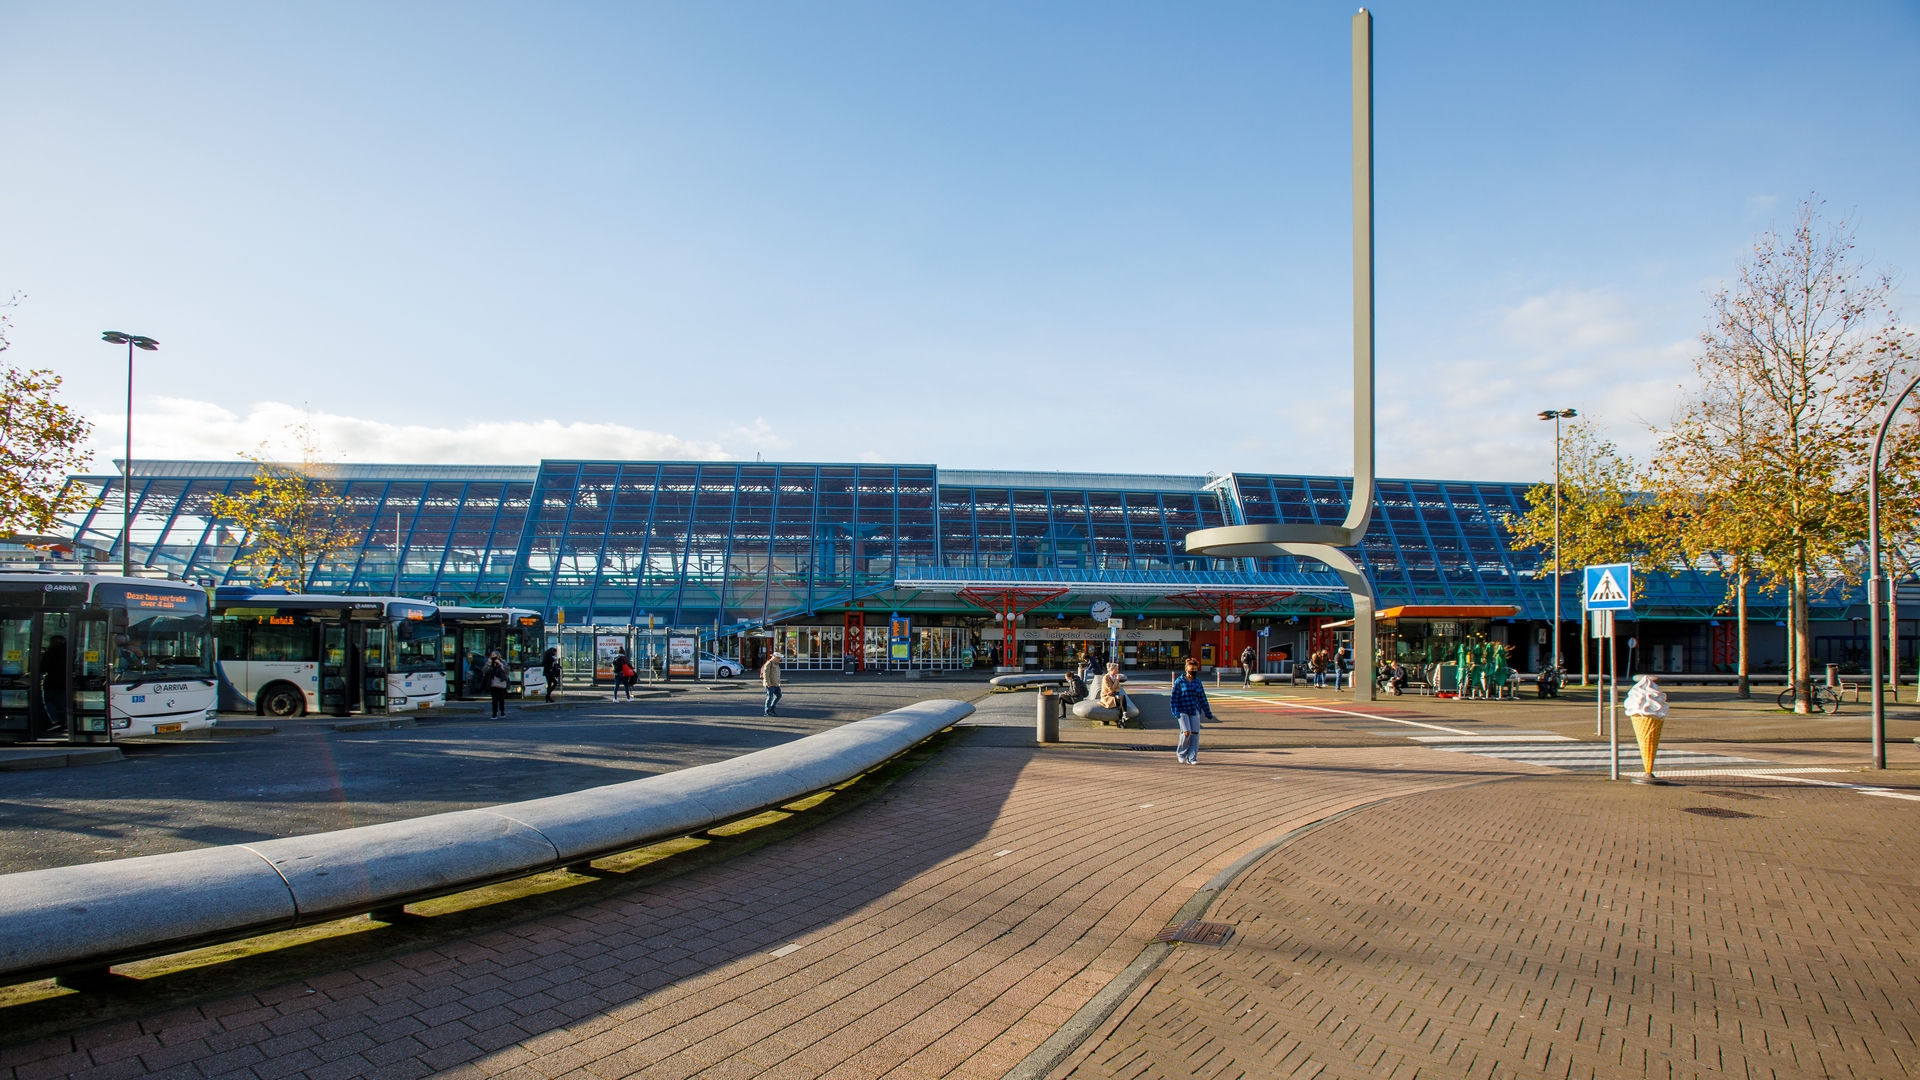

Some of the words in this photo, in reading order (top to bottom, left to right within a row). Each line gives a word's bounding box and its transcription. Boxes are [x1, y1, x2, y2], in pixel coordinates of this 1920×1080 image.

[126, 592, 144, 600] Deze
[145, 593, 159, 601] bus
[159, 594, 187, 603] vertrekt
[258, 616, 263, 624] 2
[1046, 631, 1082, 639] Lelystad
